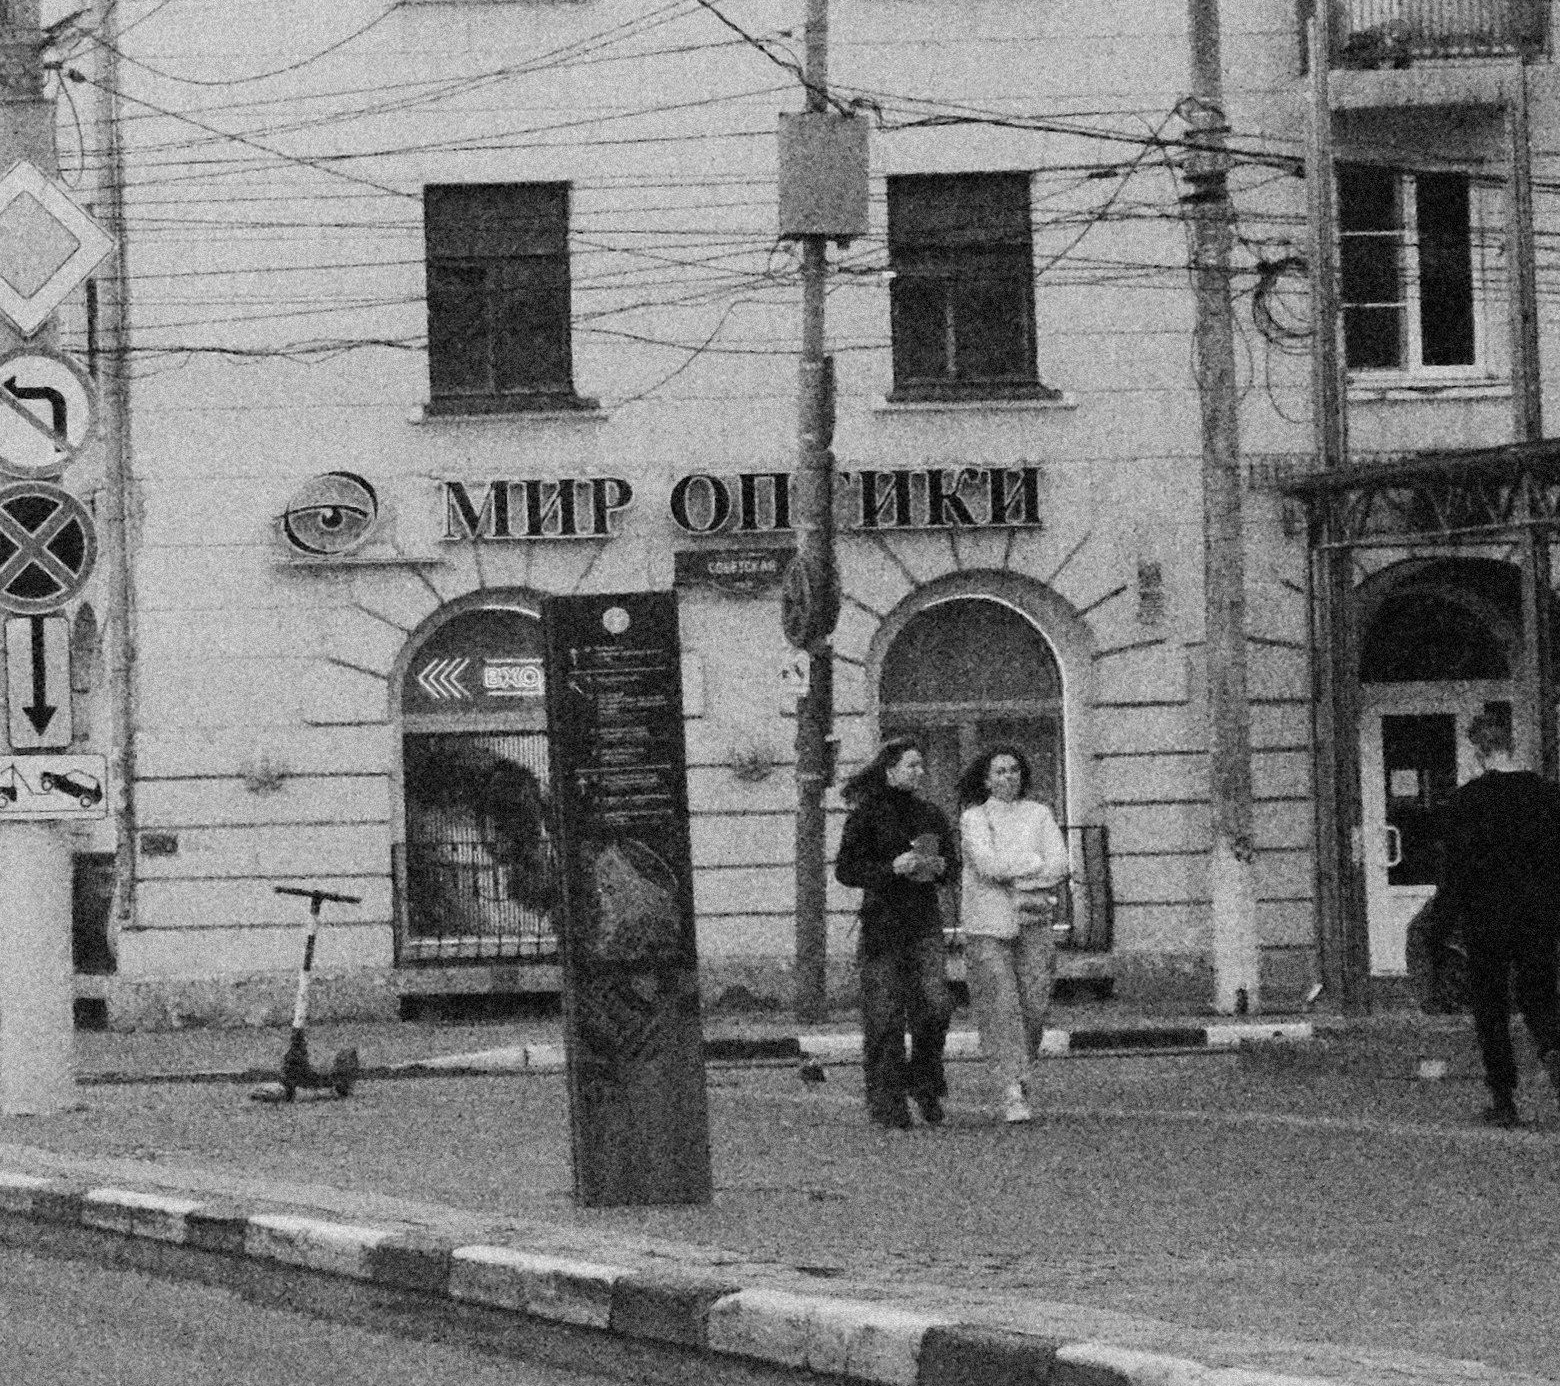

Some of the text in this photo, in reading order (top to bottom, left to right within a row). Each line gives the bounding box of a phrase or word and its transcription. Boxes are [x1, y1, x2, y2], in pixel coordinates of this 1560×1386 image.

[440, 465, 1044, 540] МИР ОПИКИ
[483, 666, 545, 690] ВХО
